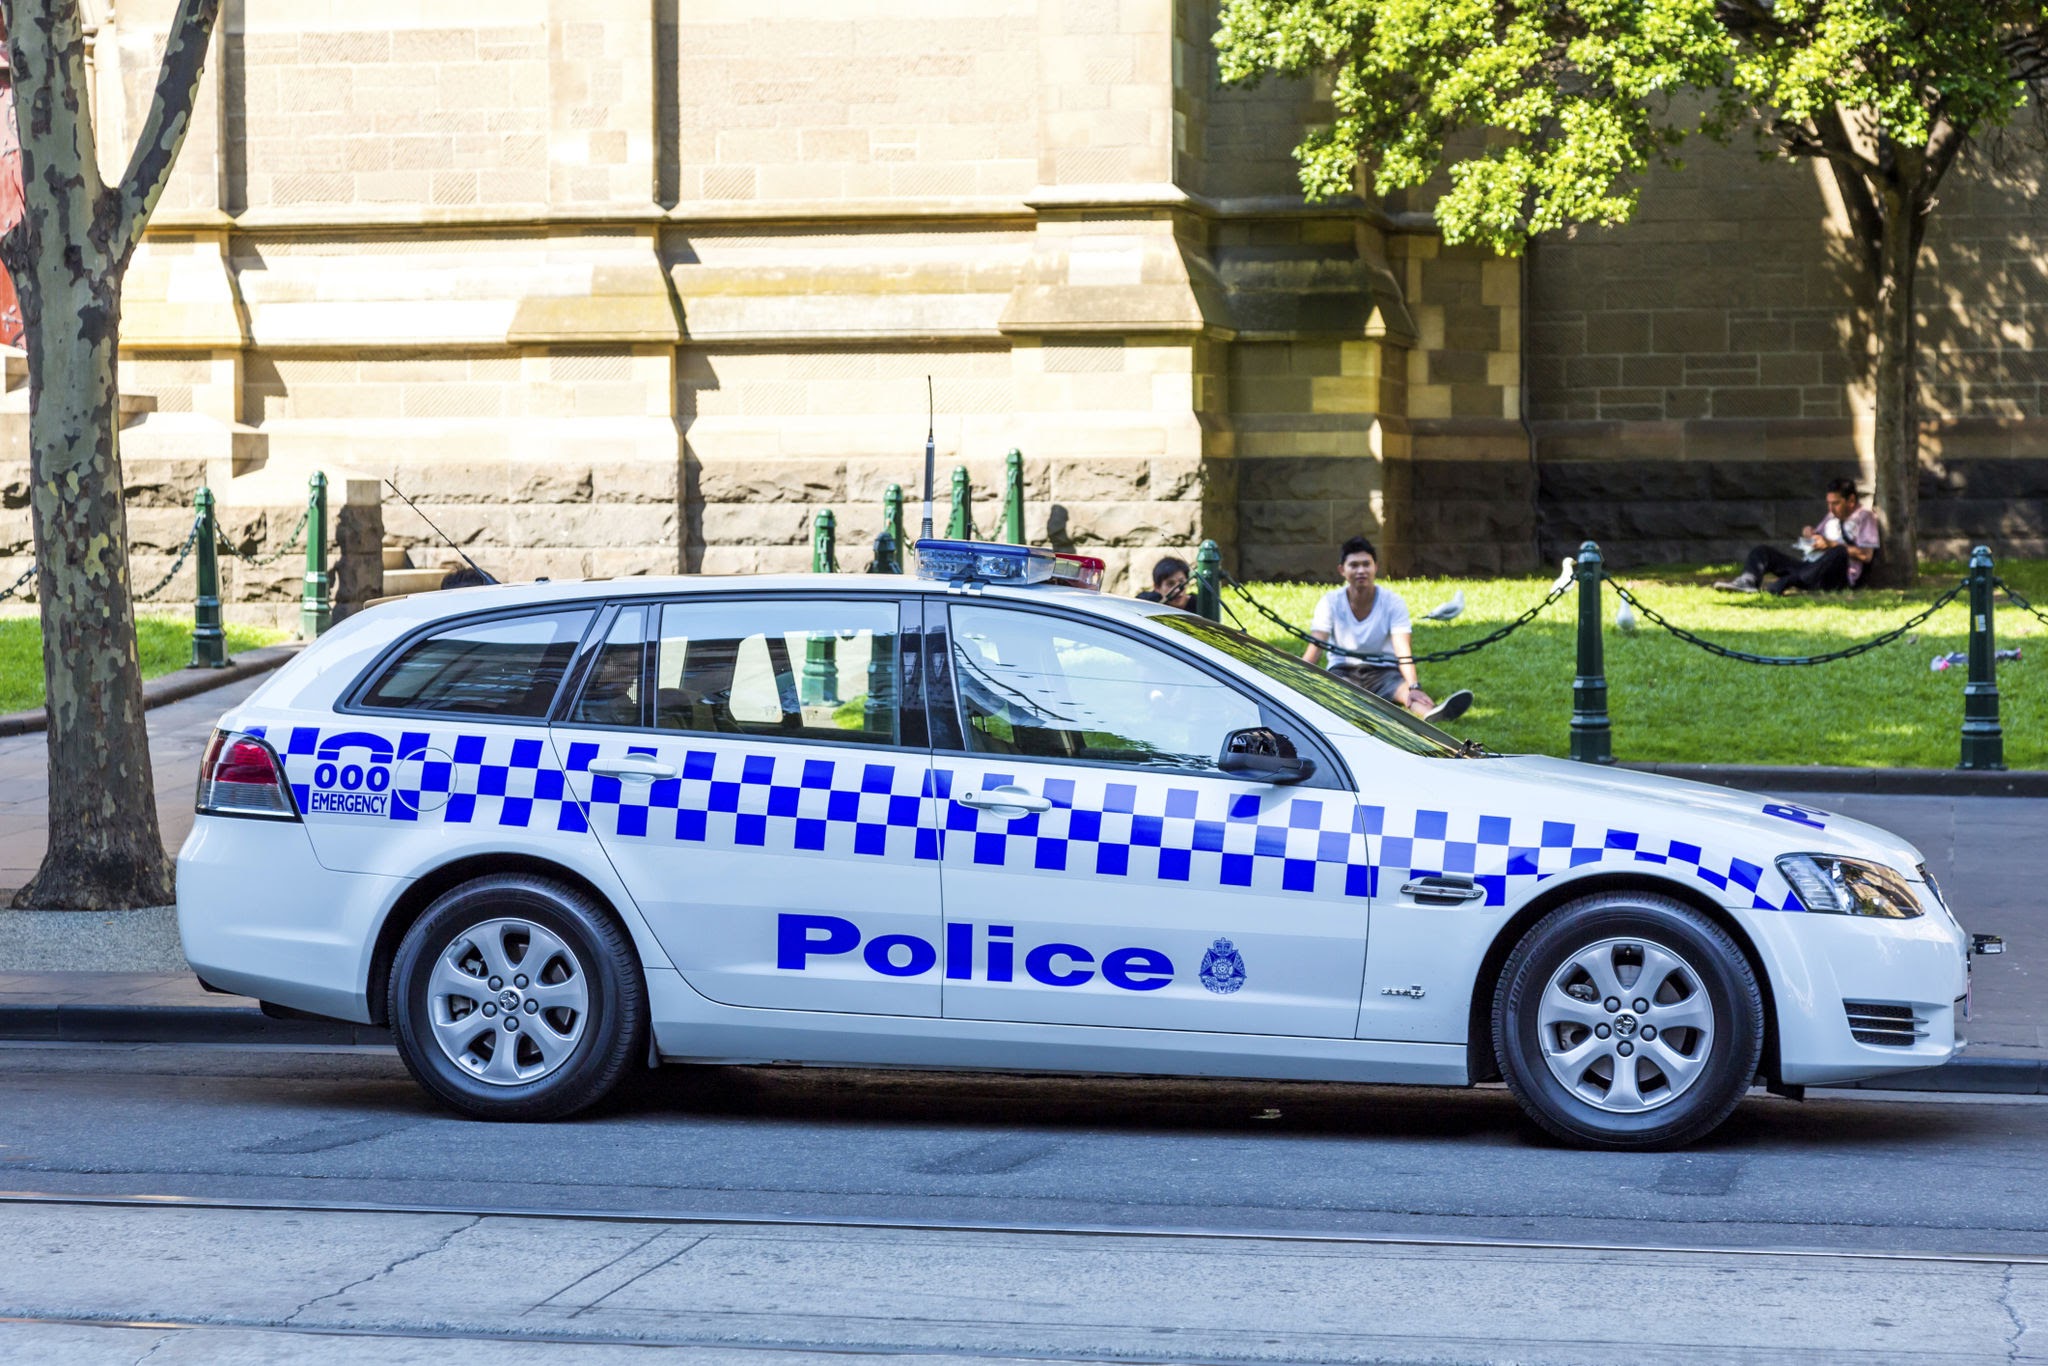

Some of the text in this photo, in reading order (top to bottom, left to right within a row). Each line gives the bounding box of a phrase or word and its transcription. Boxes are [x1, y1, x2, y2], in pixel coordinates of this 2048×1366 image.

[314, 763, 390, 792] 000
[312, 793, 387, 814] EMERGENCY
[777, 912, 1175, 991] Police
